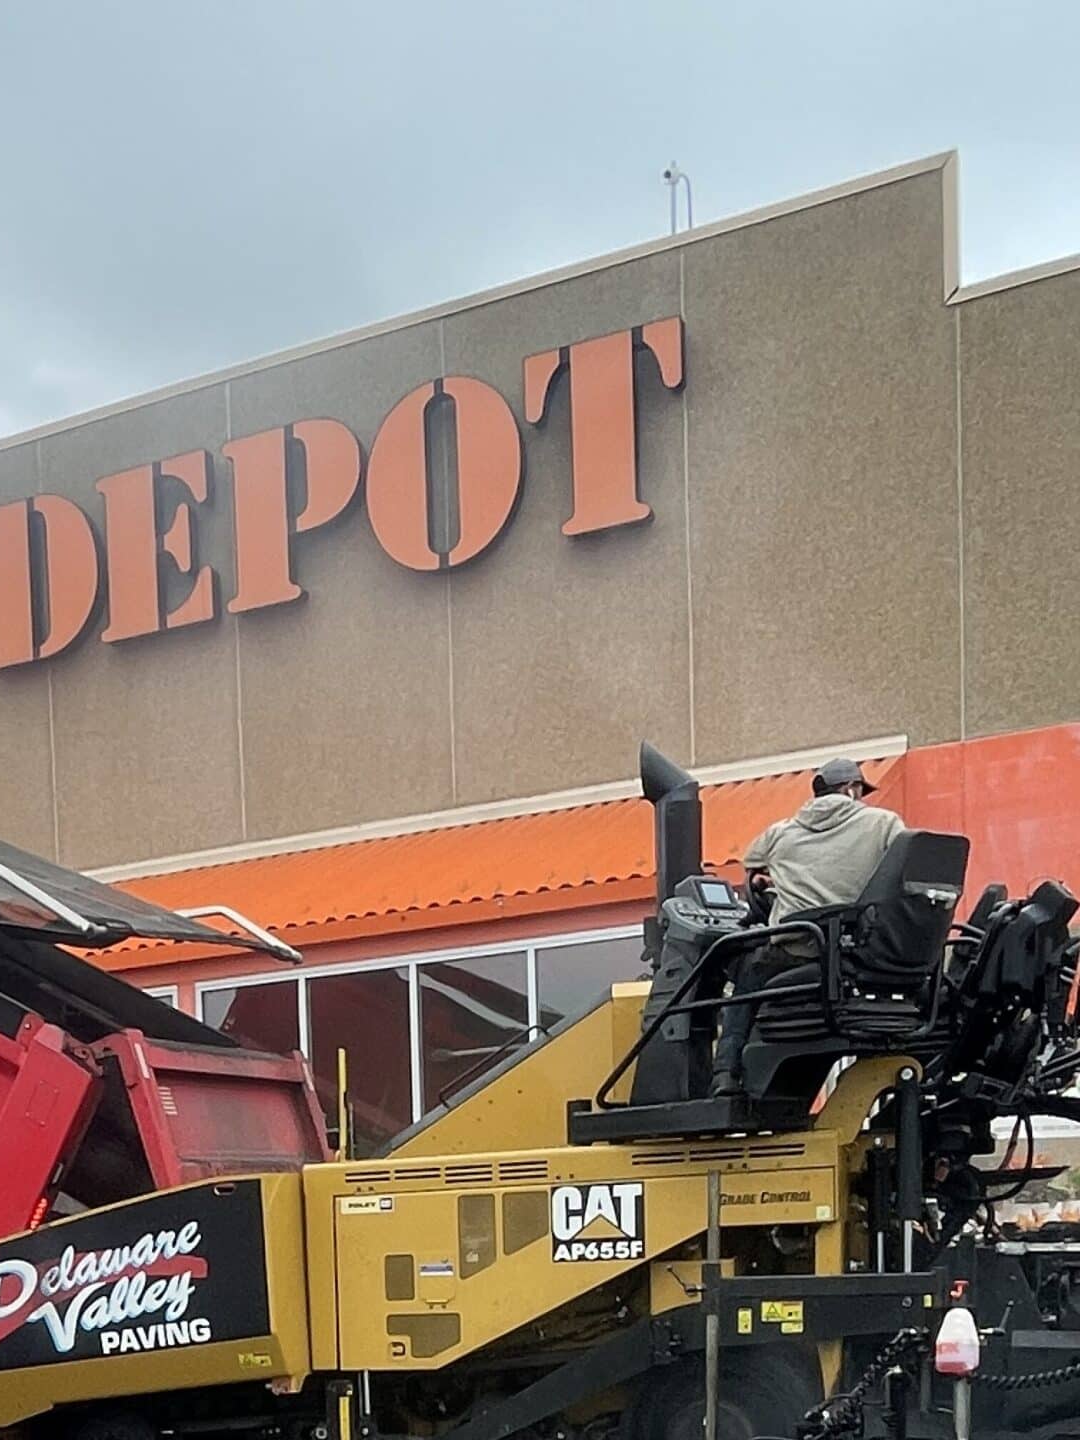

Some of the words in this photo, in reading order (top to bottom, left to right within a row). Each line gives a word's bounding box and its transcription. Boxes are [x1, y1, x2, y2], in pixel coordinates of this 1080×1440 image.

[551, 1183, 643, 1242] CAT
[553, 1241, 645, 1261] AP655F
[27, 1270, 196, 1352] Valley
[100, 1318, 212, 1354] PAVING
